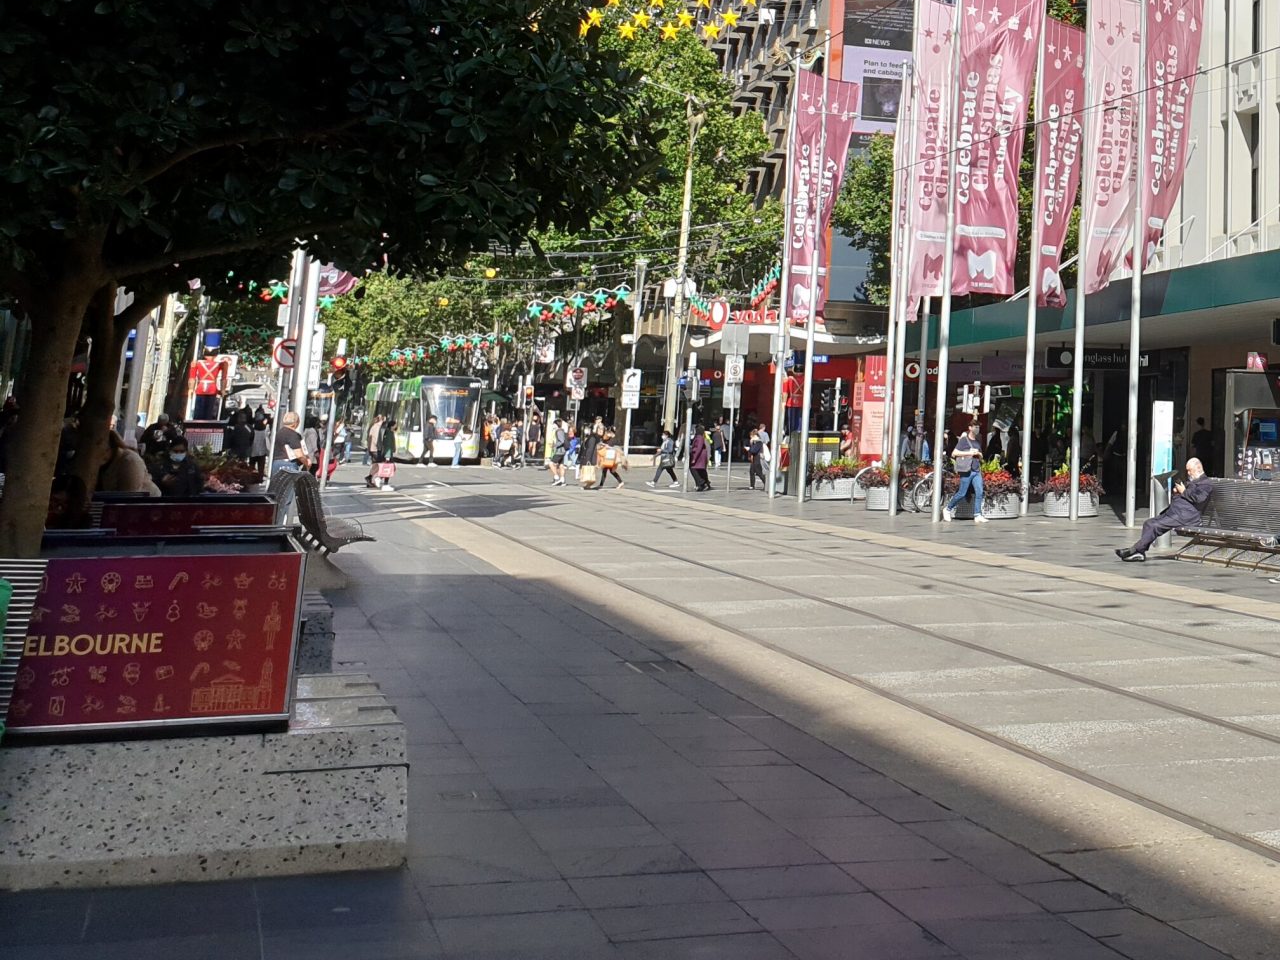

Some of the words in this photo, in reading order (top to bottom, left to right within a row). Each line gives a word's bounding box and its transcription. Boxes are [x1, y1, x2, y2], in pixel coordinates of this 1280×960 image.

[863, 59, 879, 68] Plan
[872, 39, 891, 47] NEWS
[877, 68, 903, 78] cabbag
[918, 87, 942, 213] Celebrate
[956, 70, 981, 205] Celebrate
[971, 53, 1003, 193] Christmas
[995, 85, 1024, 138] City
[1095, 81, 1115, 208] Celebrate
[1112, 65, 1133, 194] Christmas
[1151, 60, 1166, 196] Celebrate
[1170, 78, 1190, 130] City
[793, 143, 811, 250] Celebrate
[1044, 103, 1060, 226] Celebrate
[1083, 350, 1112, 365] nglass
[1113, 350, 1128, 363] hut
[23, 632, 164, 656] ELBOURNE
